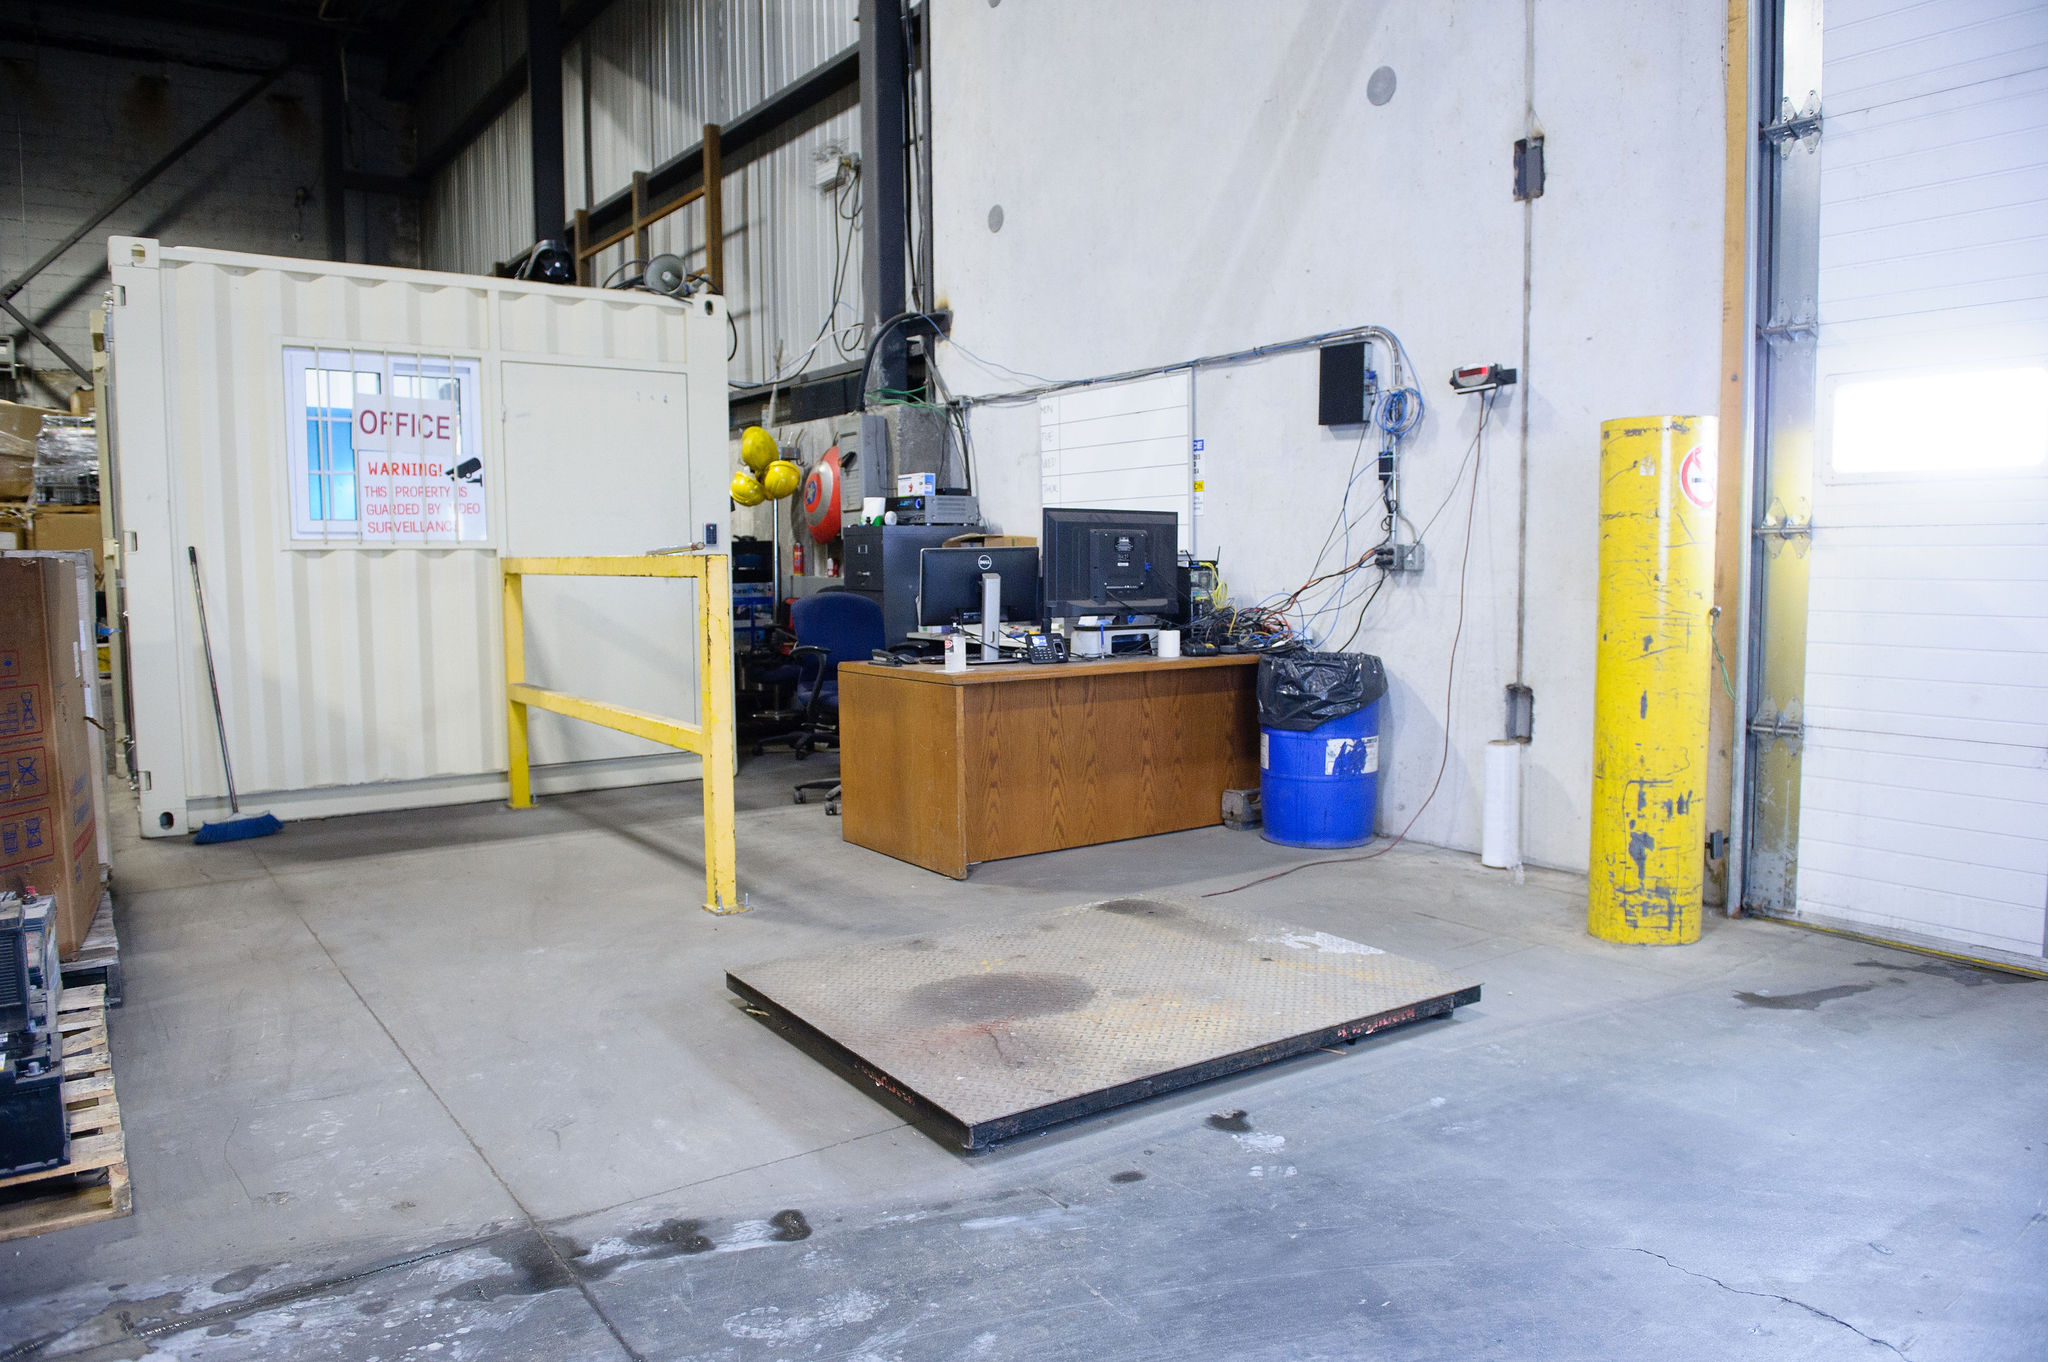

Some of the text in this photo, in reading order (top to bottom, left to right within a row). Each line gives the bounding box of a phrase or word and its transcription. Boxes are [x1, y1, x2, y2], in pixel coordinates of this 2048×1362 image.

[360, 410, 450, 440] OFFICE
[368, 462, 443, 477] WARNING!
[364, 486, 467, 498] THIS PROPERTY IS
[366, 503, 481, 515] GUARDED BY DEO
[367, 521, 458, 533] SURVEILLANC
